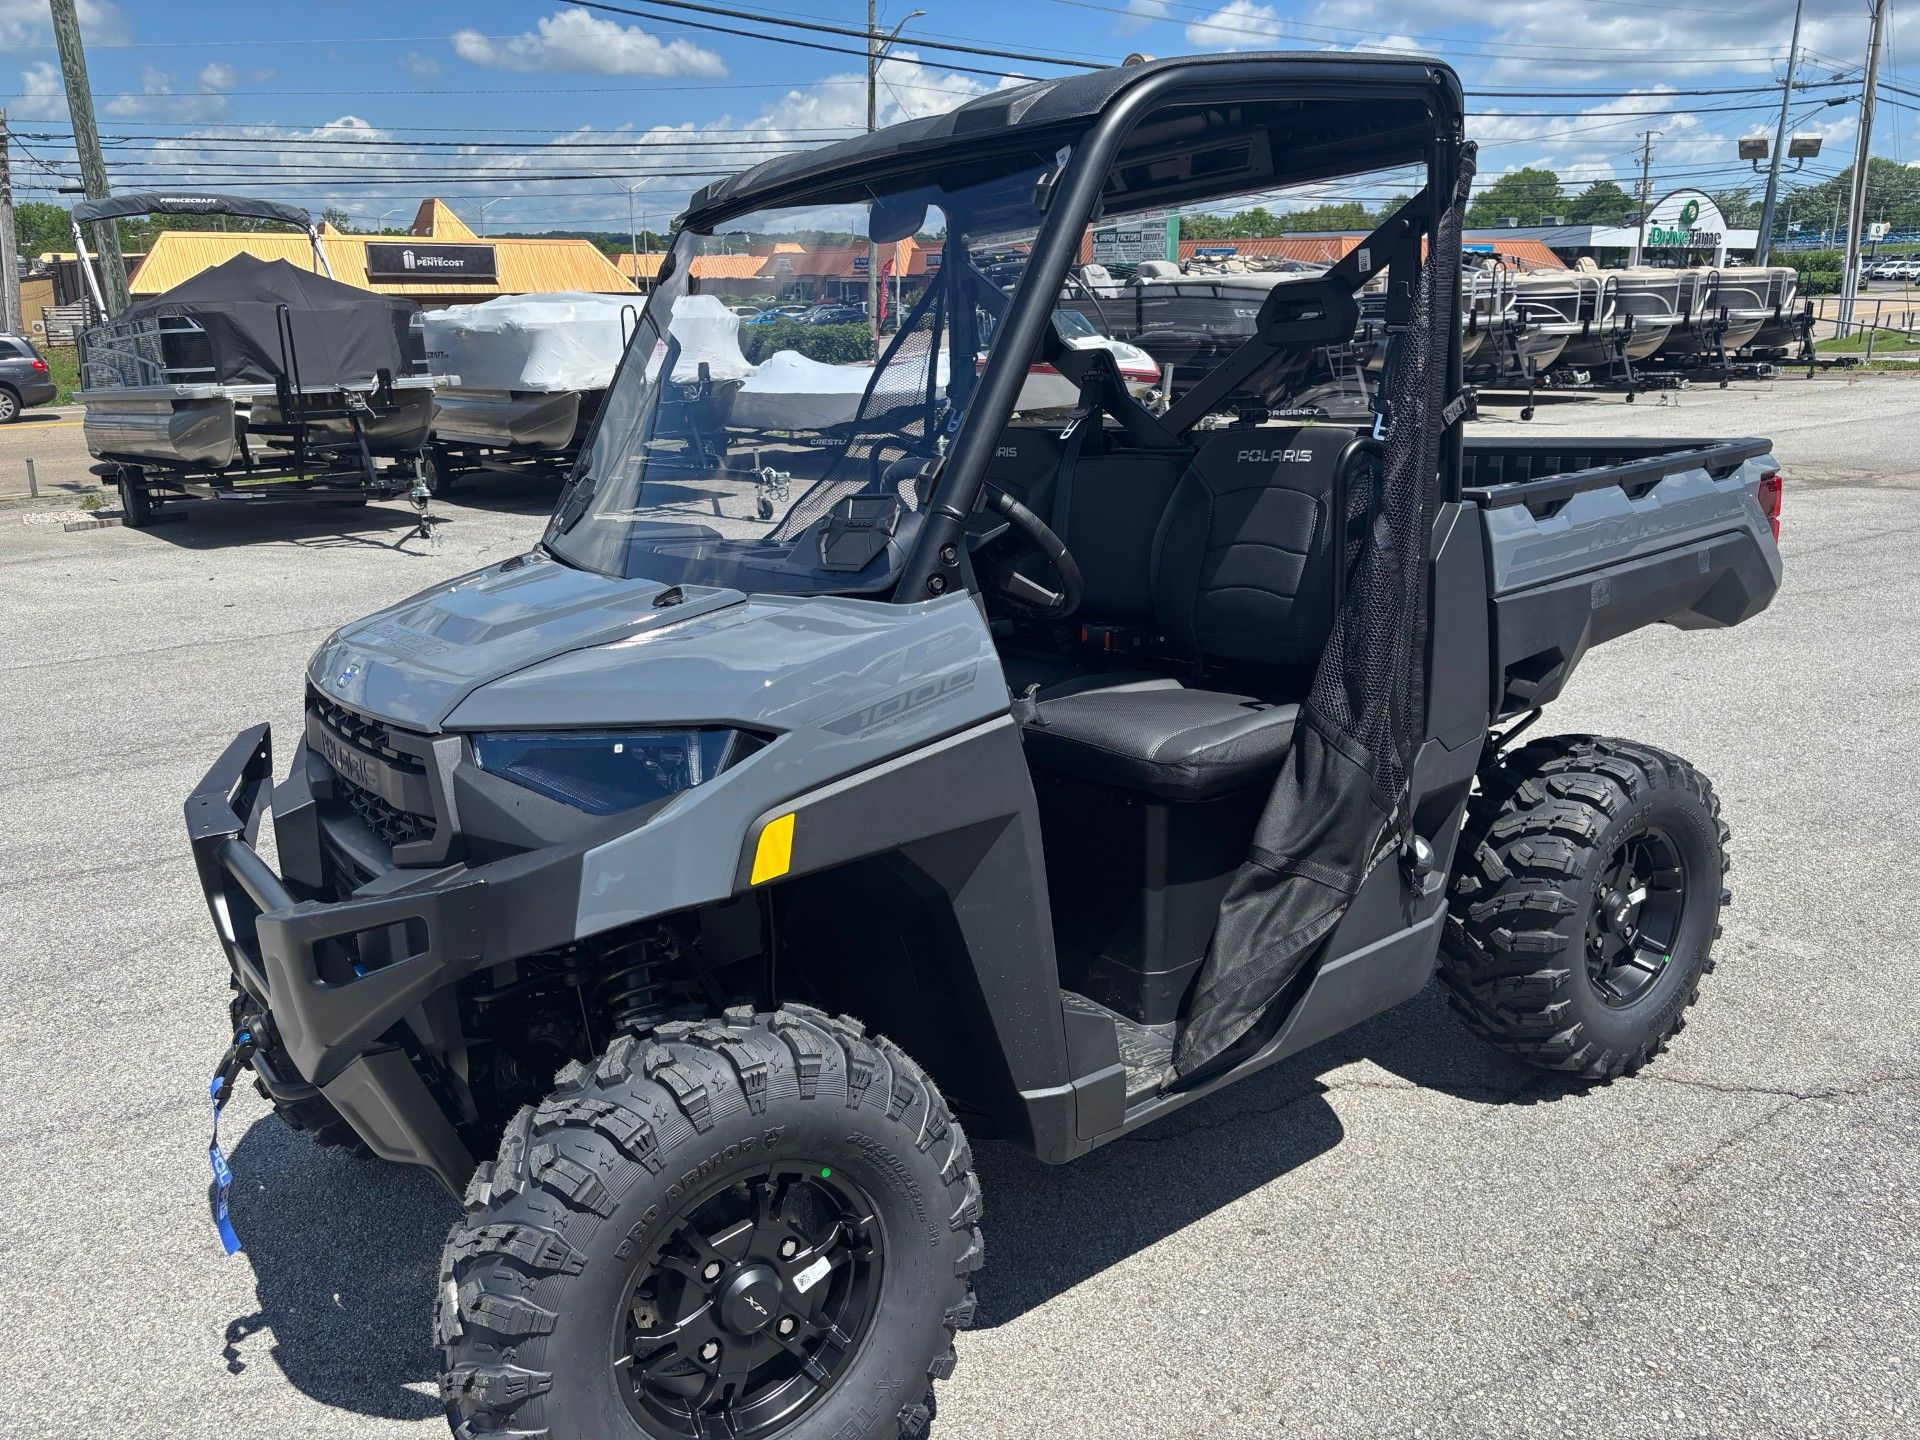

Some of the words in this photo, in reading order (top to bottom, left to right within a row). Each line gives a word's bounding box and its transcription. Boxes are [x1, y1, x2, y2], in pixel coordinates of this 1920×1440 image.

[1118, 232, 1141, 241] FACTORY
[1650, 227, 1722, 245] DriveTime
[416, 259, 464, 267] PENTECOST
[1272, 408, 1320, 416] REGENCY
[1236, 449, 1313, 463] POLARIS
[857, 664, 976, 729] 1000
[320, 728, 378, 785] POLARIS
[213, 1146, 231, 1220] POLARIS
[664, 1136, 758, 1214] ARMOR
[743, 1295, 768, 1316] XP
